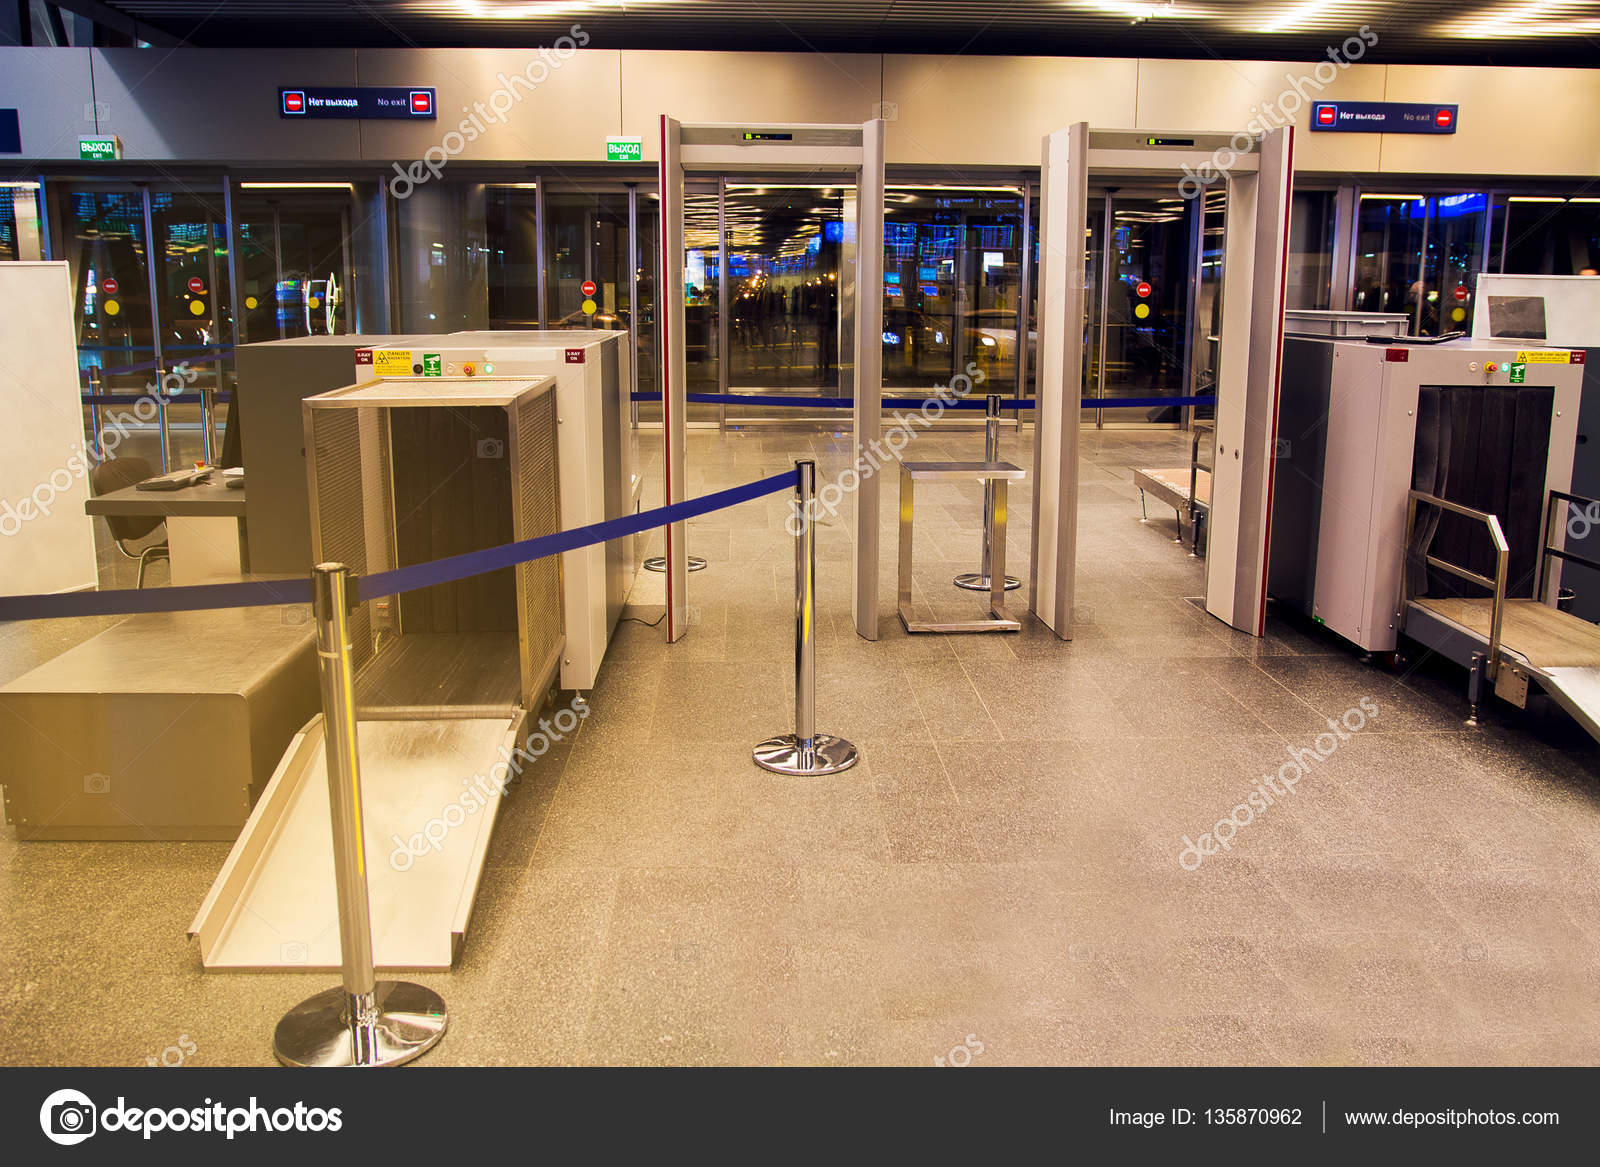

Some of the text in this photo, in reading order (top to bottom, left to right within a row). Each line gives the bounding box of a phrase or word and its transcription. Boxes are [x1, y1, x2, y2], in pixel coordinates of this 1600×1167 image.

[308, 97, 358, 108] Нет выхода
[377, 98, 406, 106] No exit
[1339, 111, 1386, 121] Нет выхода
[1403, 113, 1430, 121] No exit
[81, 142, 114, 154] ВЫХОД
[609, 144, 640, 155] ВЫХОД
